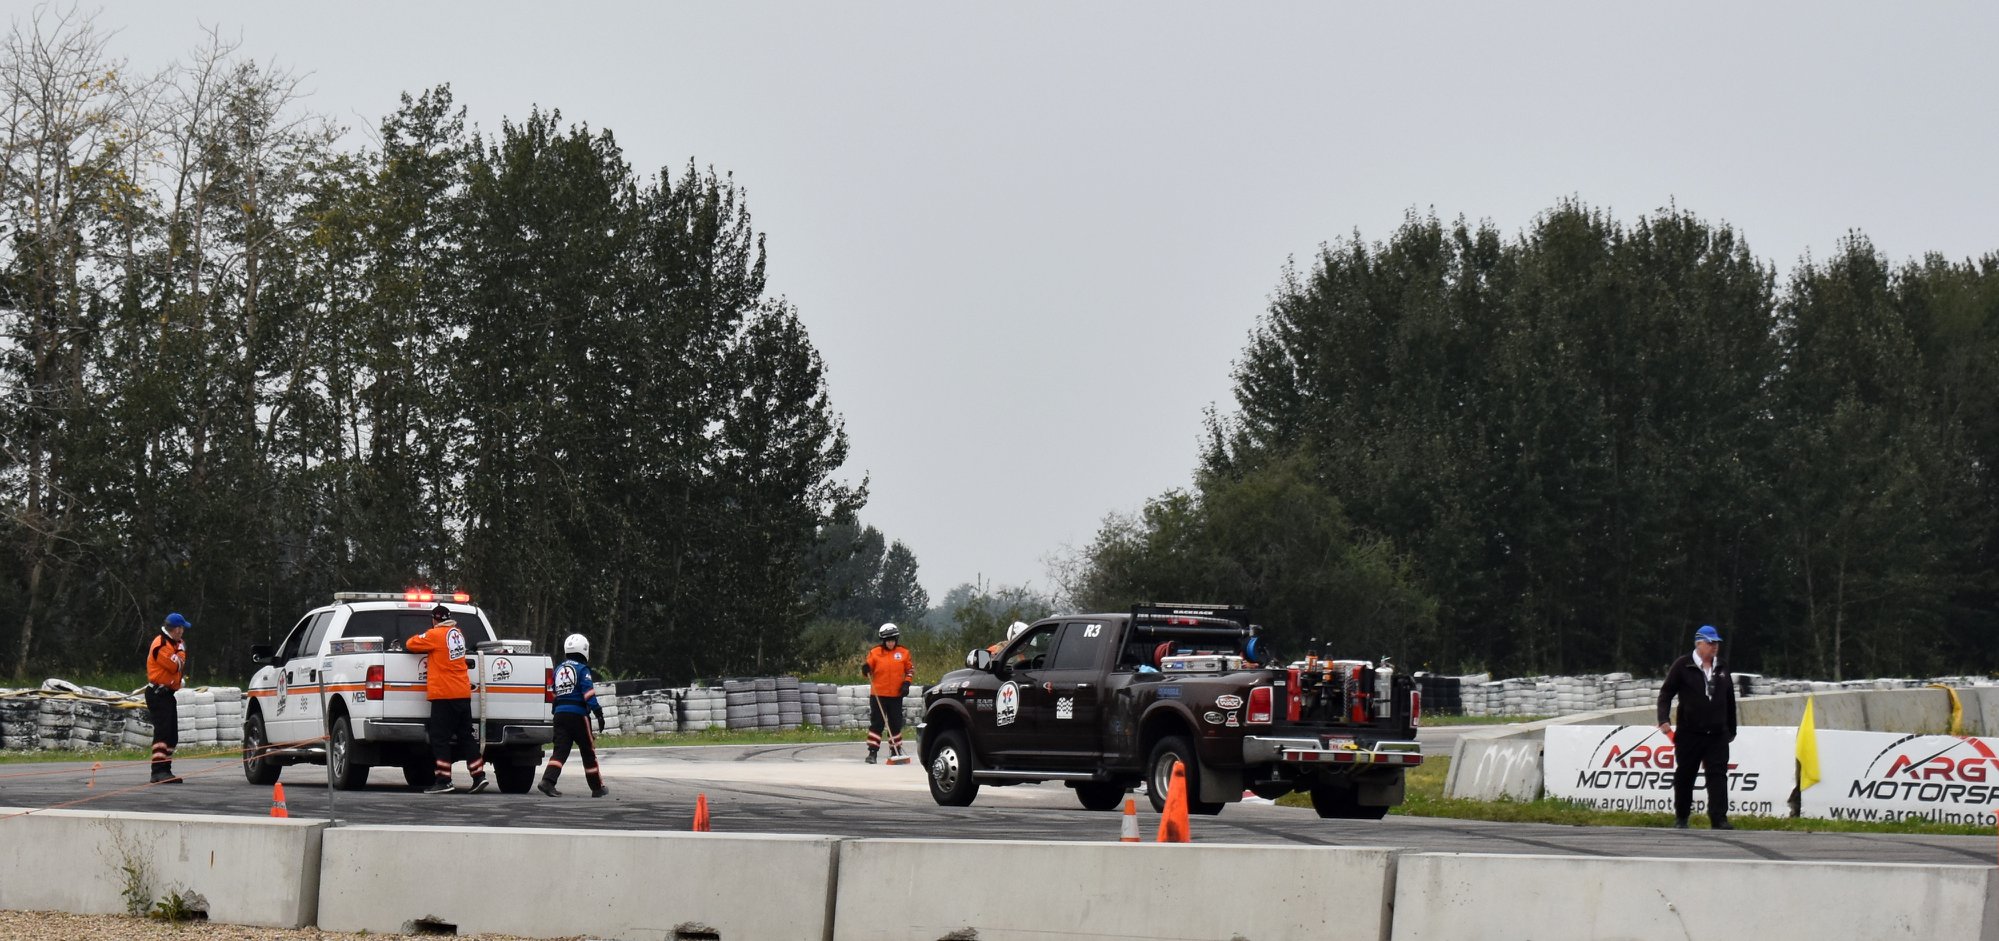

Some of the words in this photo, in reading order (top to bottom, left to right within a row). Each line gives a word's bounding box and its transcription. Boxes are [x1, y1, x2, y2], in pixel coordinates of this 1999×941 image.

[1083, 624, 1101, 638] R3
[1884, 754, 1999, 783] ARG
[1576, 770, 1760, 792] MOTORSOTS
